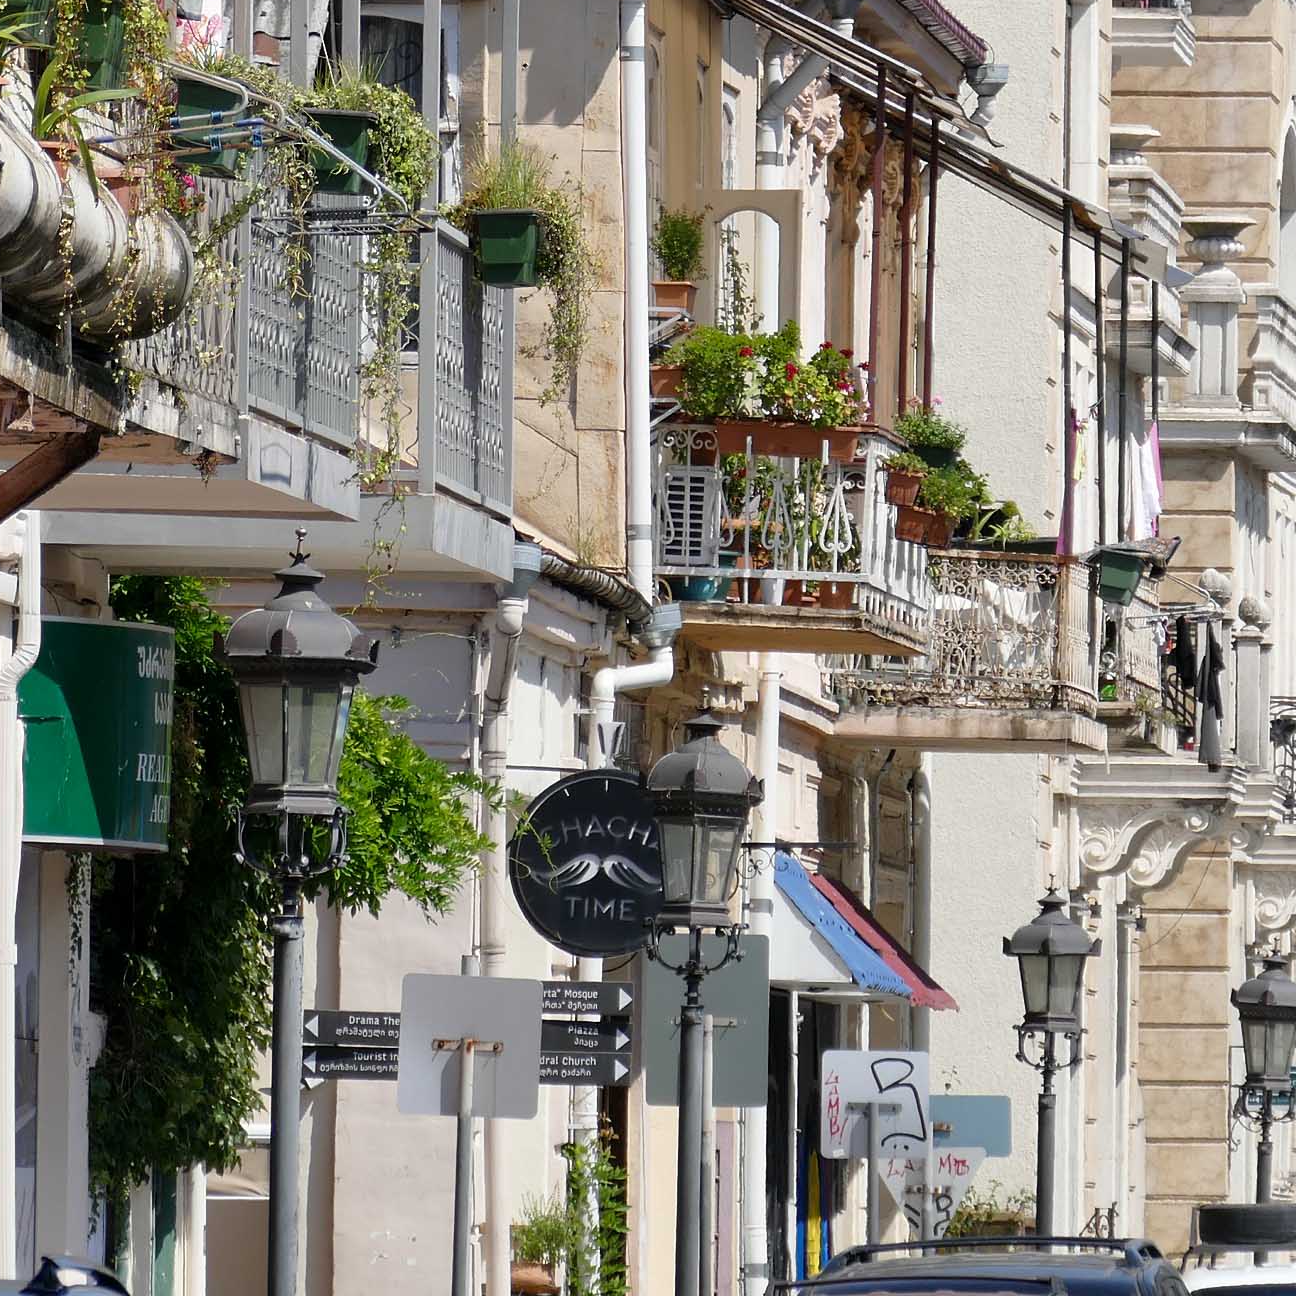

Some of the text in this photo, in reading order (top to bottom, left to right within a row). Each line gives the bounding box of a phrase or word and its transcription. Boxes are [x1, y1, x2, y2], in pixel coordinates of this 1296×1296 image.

[540, 815, 659, 849] CHACH
[565, 897, 636, 921] TIME
[564, 989, 599, 1000] Mosque
[348, 1016, 380, 1025] Drama
[568, 1025, 599, 1035] Piazza
[352, 1052, 387, 1061] Tourist
[562, 1056, 597, 1066] Church
